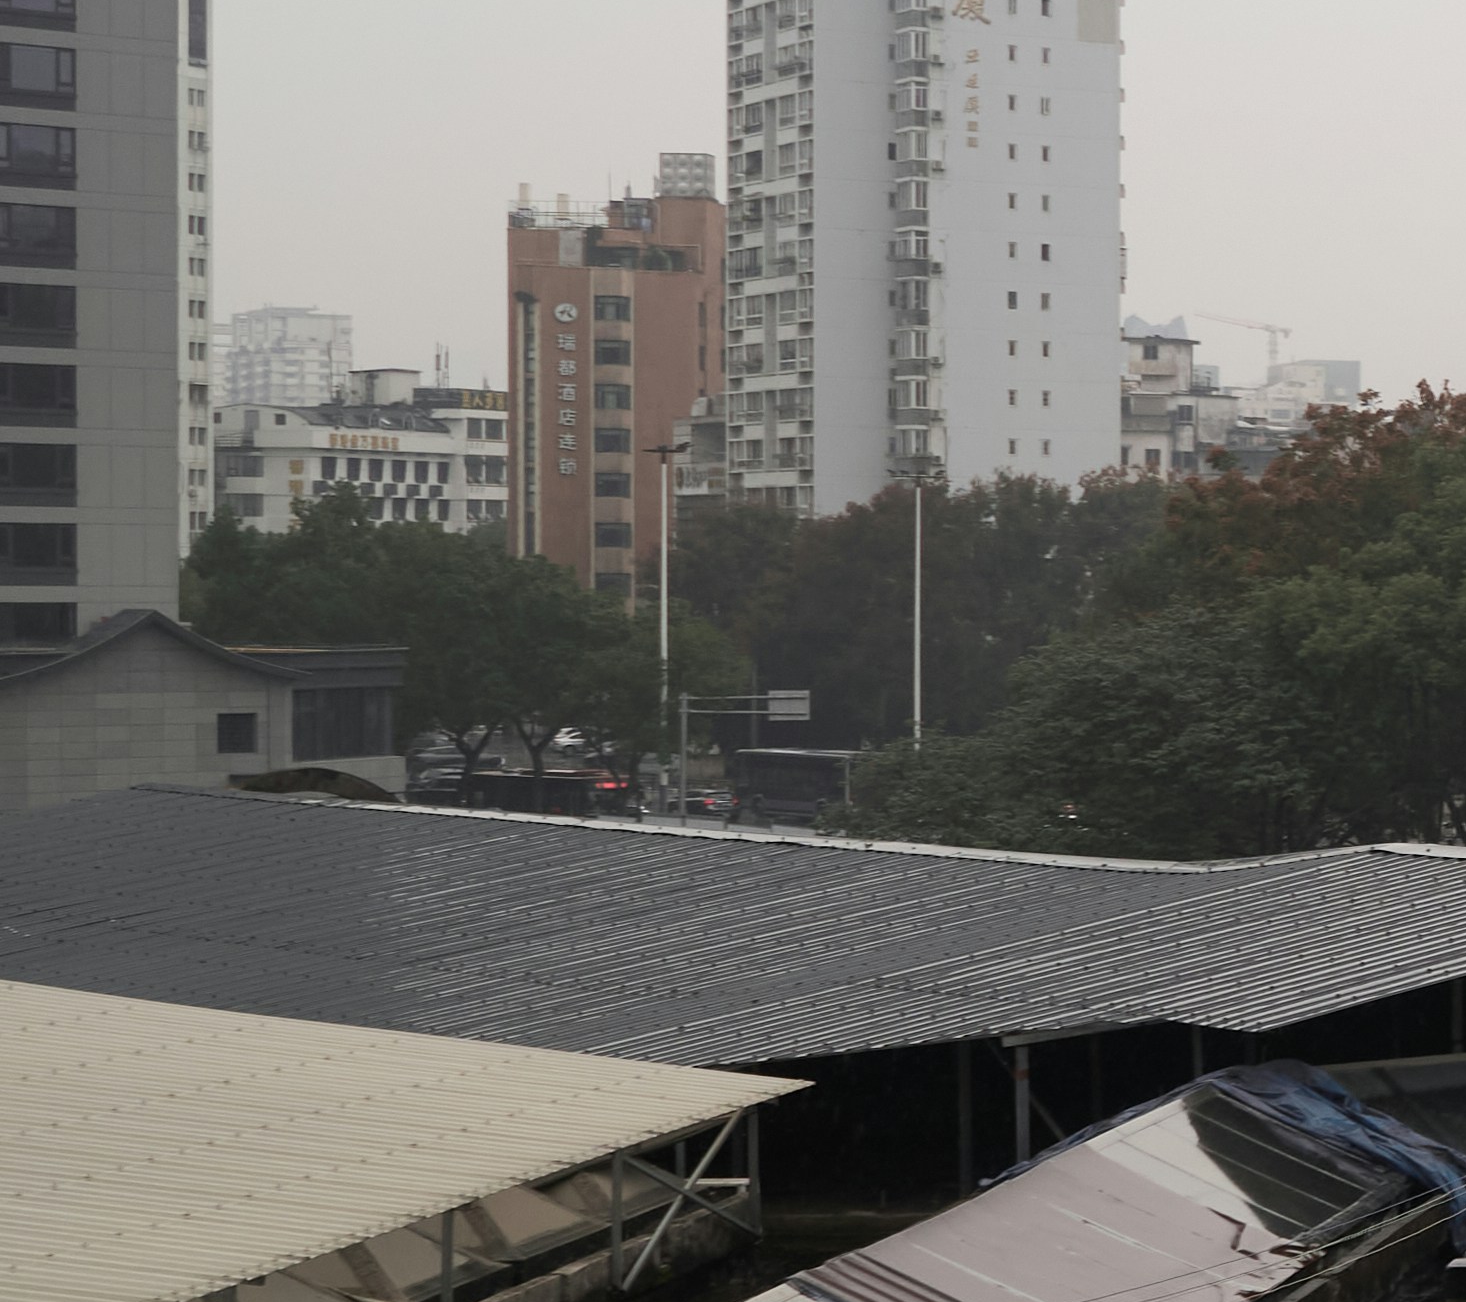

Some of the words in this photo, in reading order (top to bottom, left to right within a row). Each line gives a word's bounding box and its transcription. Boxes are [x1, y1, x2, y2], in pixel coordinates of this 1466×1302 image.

[556, 332, 578, 477] 瑞都酒店连锁
